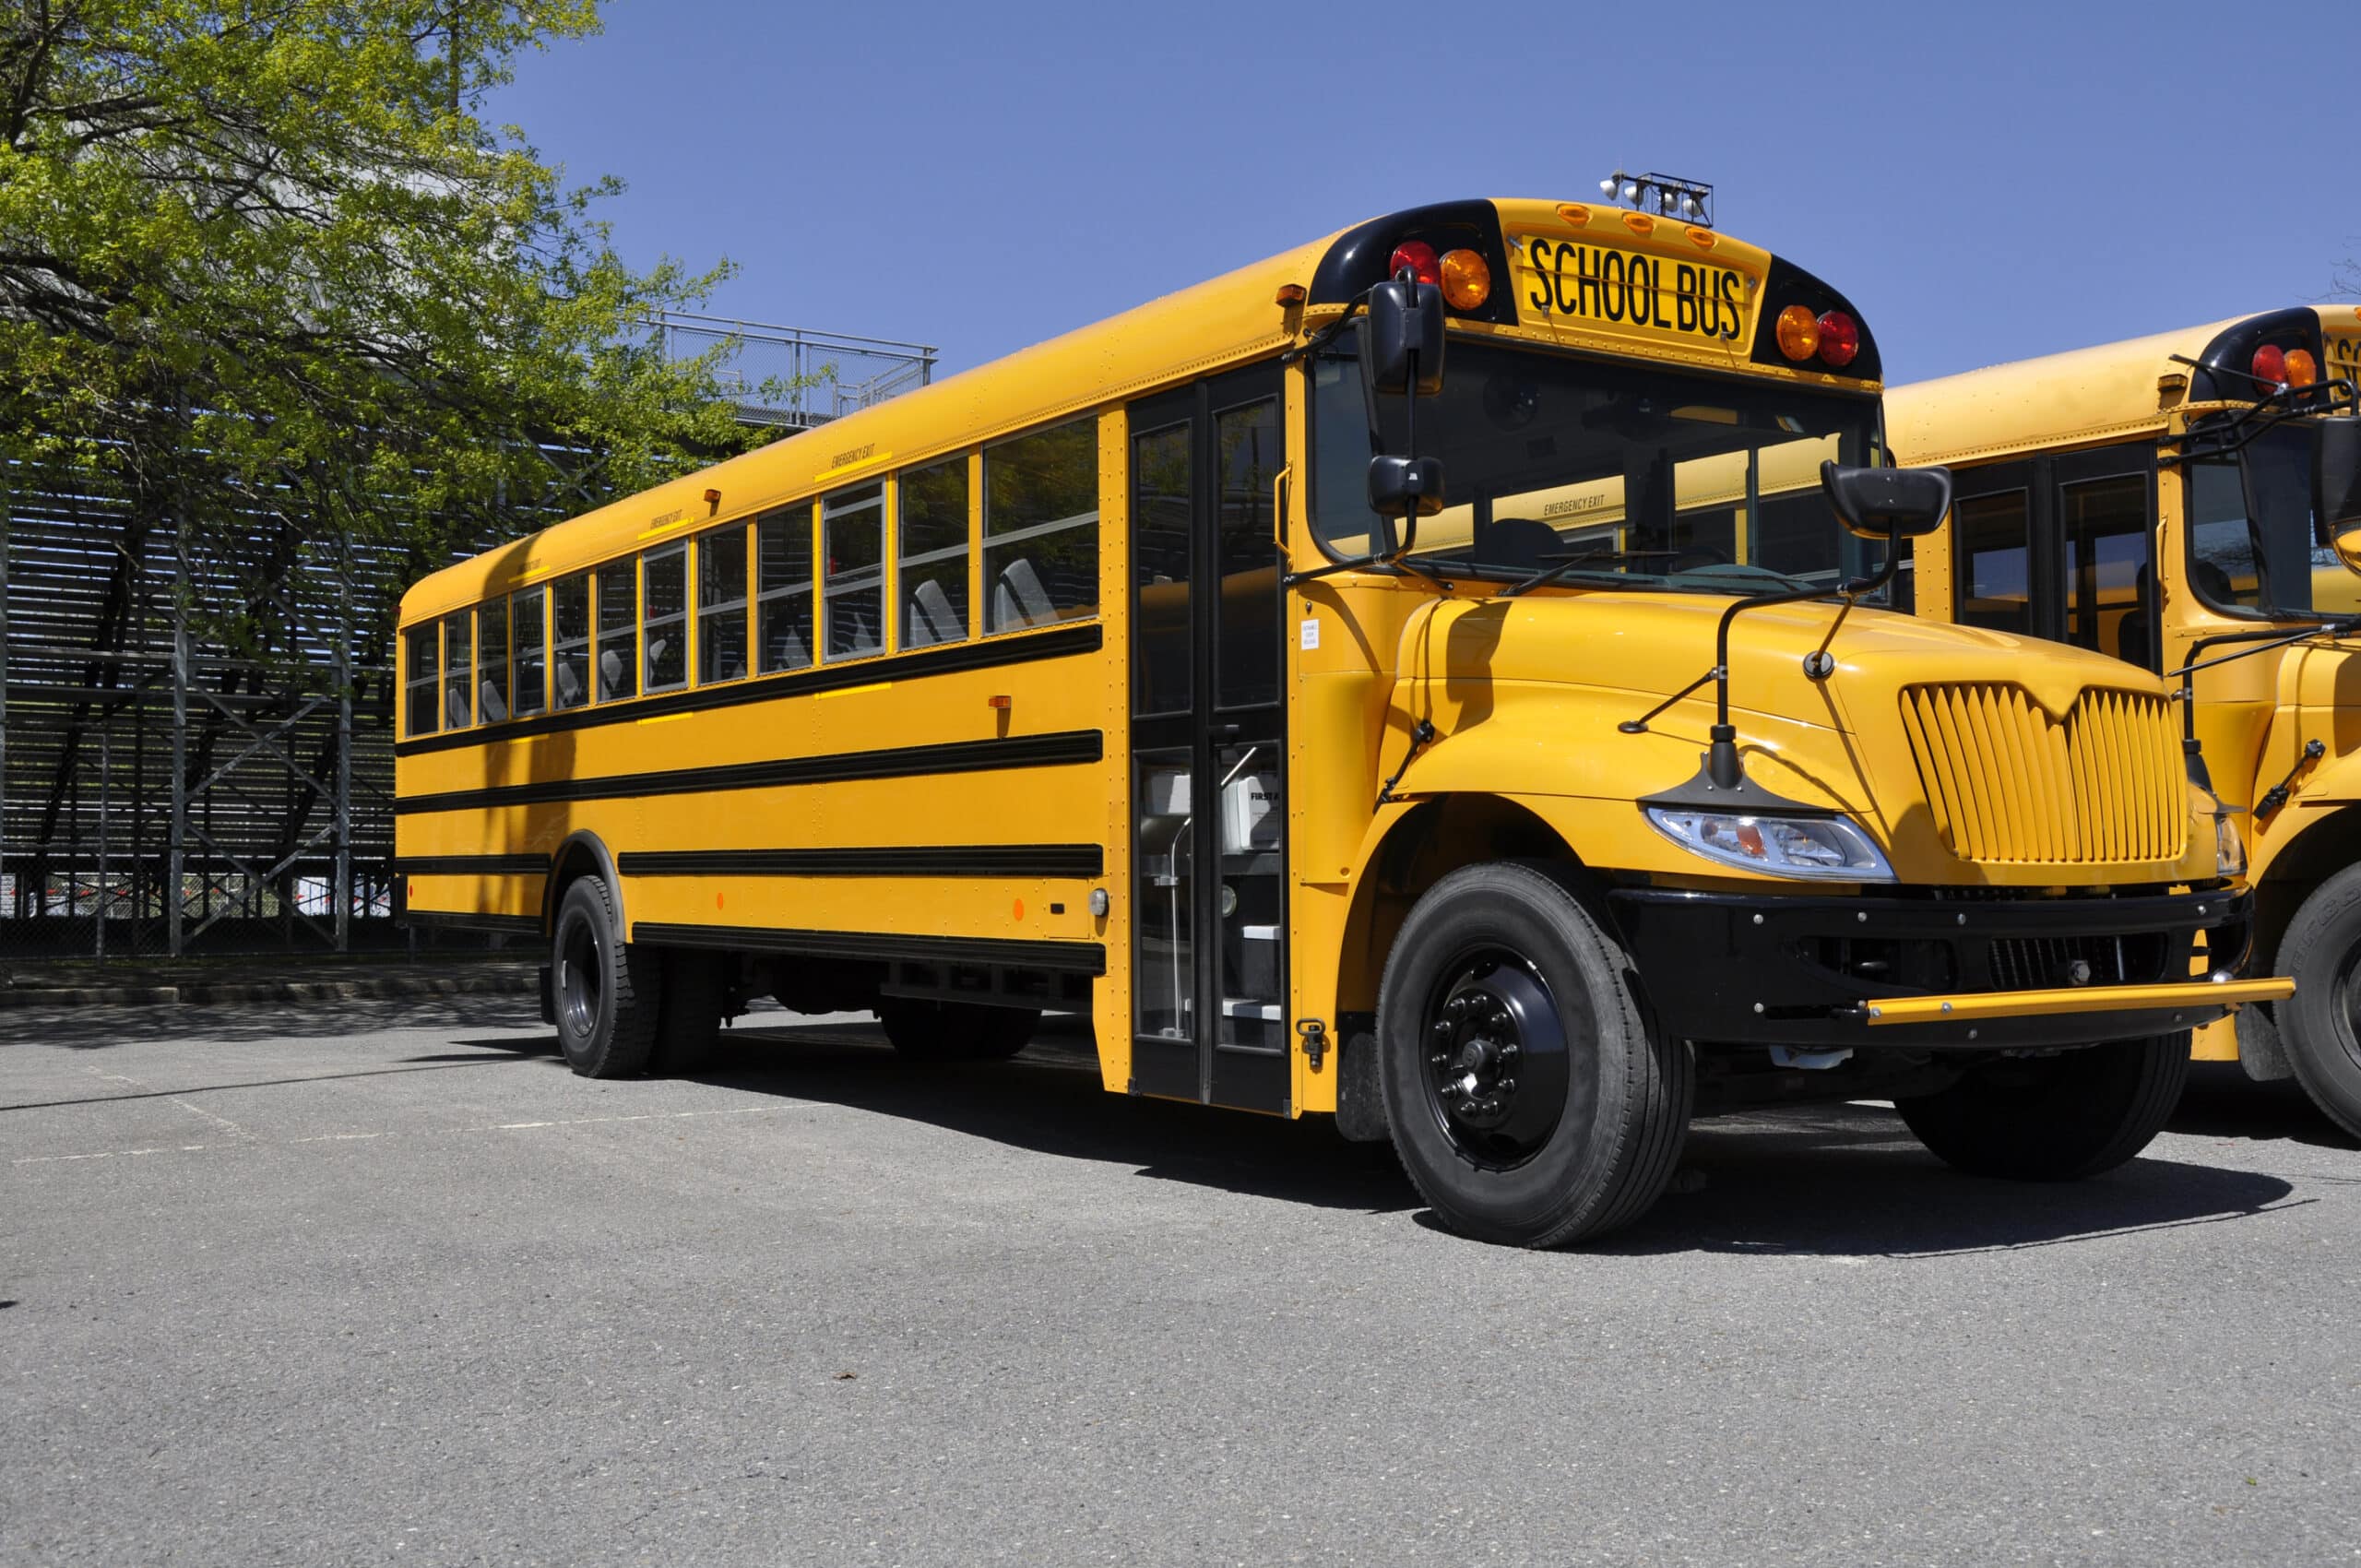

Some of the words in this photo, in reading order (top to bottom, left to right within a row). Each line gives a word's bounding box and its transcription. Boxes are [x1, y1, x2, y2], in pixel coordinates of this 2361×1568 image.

[1530, 237, 1672, 329] SCHOOL
[1676, 264, 1741, 340] BUS
[1544, 497, 1588, 517] EMERGENCY
[1587, 493, 1606, 508] EXIT
[1251, 791, 1273, 801] FIRST
